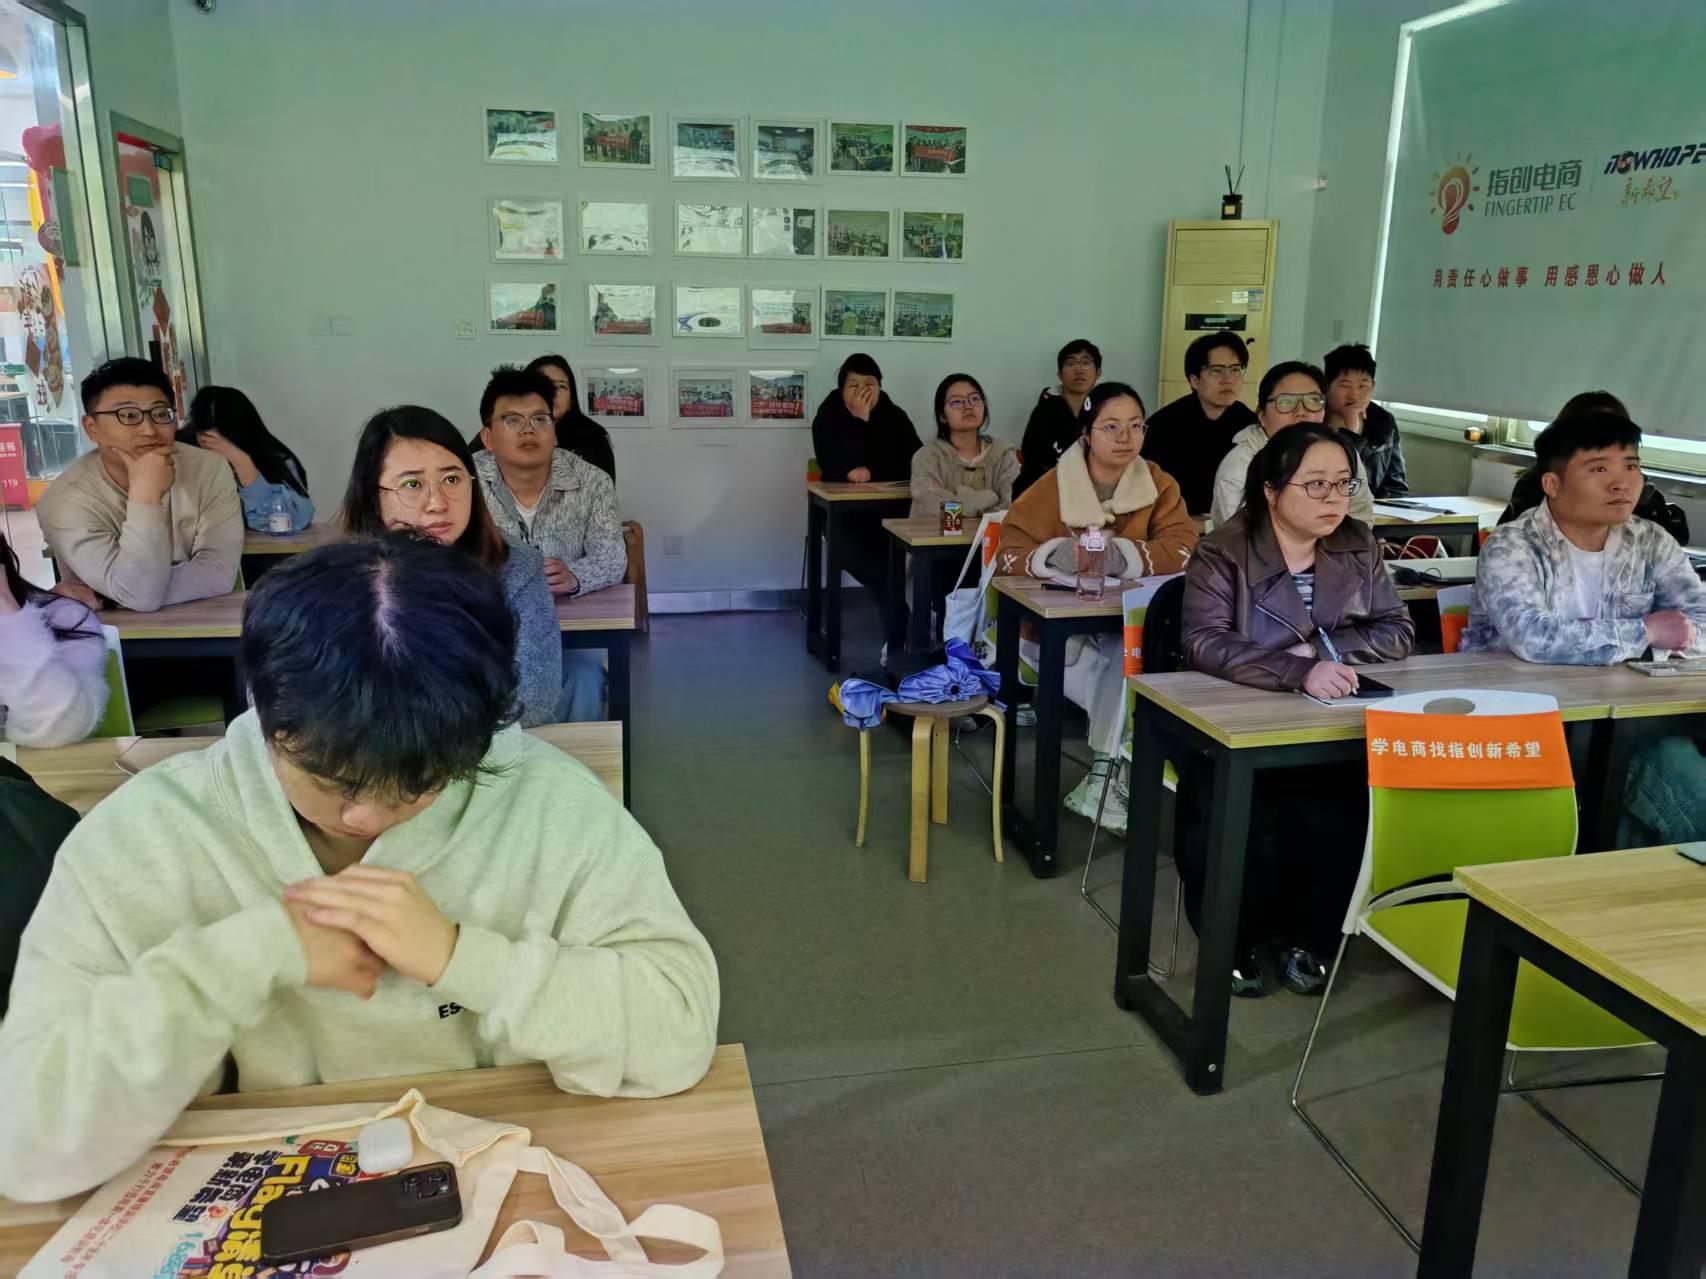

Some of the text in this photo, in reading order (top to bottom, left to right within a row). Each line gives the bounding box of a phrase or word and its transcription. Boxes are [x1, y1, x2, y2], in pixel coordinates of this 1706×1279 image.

[1486, 160, 1583, 197] 指创电商
[1484, 193, 1577, 217] FINGERTIP EC
[1433, 261, 1666, 288] 用责任心做事 用感恩心做人
[1370, 738, 1542, 759] 学电商找指创新希望
[438, 1002, 464, 1019] ES
